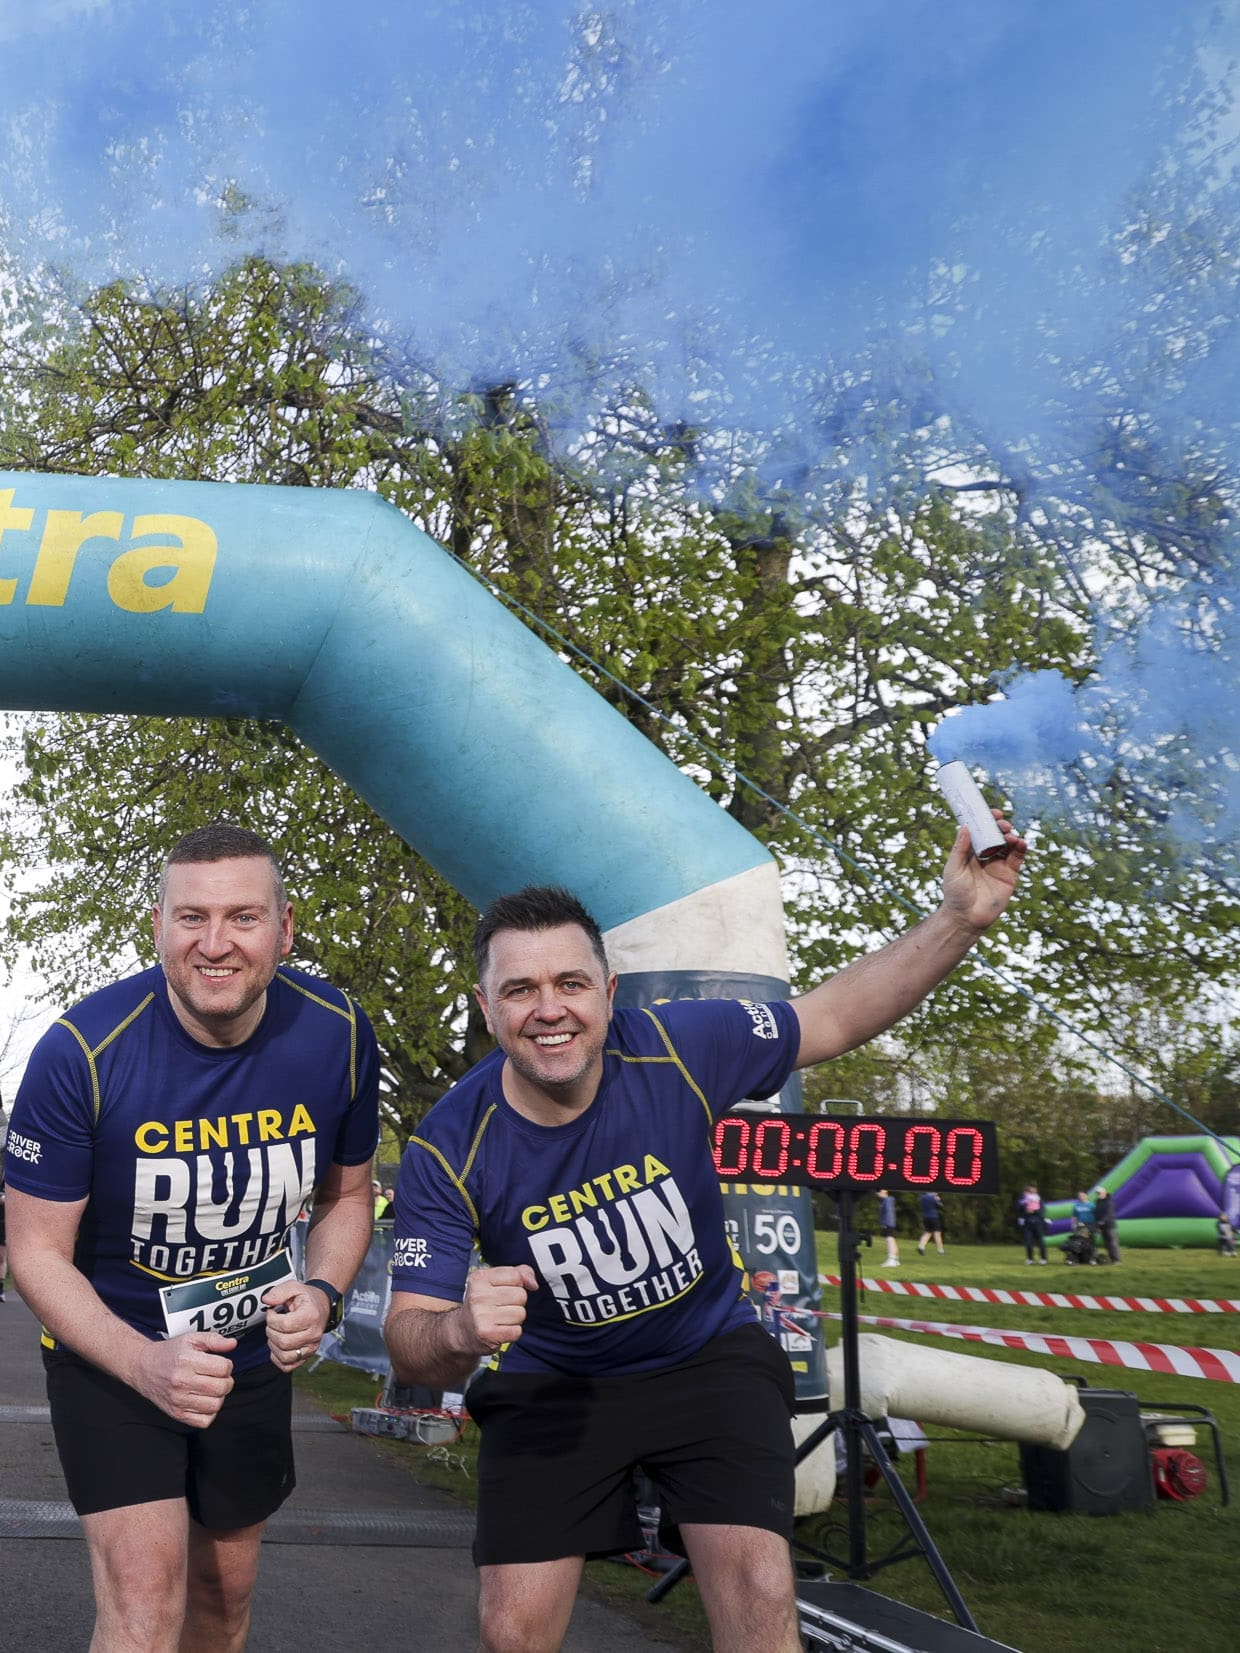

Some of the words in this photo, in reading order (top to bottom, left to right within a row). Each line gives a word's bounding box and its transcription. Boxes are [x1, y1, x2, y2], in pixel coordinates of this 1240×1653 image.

[134, 1103, 317, 1154] CENTRA
[131, 1137, 316, 1244] RUN
[521, 1153, 671, 1232] CENTRA
[130, 1232, 290, 1276] TOGETHE
[527, 1176, 696, 1299] RUN
[754, 1214, 802, 1255] 50
[215, 1275, 250, 1291] Centra
[556, 1248, 704, 1323] TOGETHER
